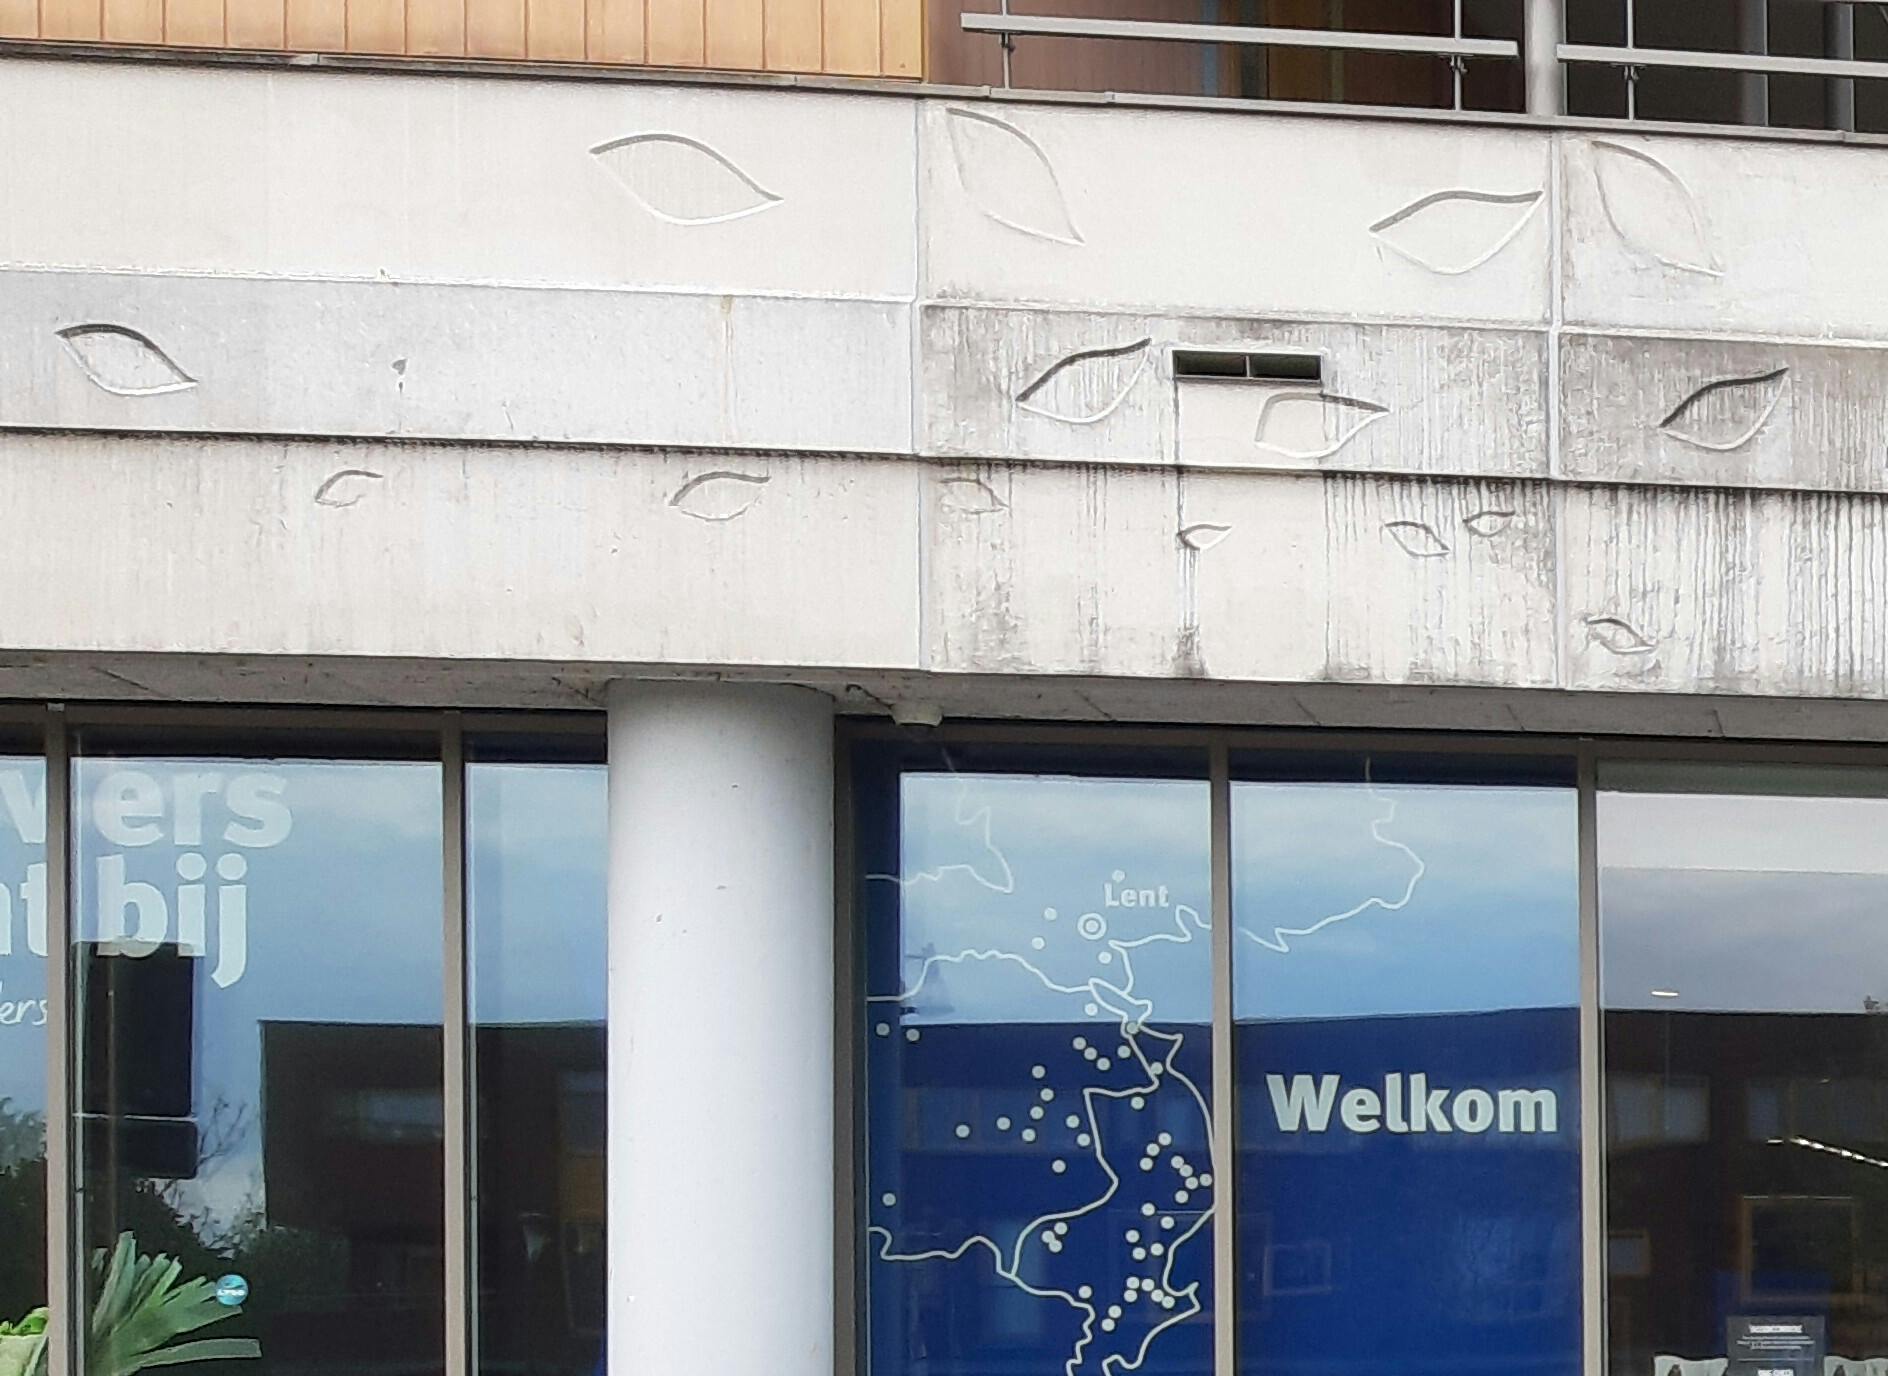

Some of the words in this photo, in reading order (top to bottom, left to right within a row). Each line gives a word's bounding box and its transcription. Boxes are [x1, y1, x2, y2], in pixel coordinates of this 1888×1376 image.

[96, 852, 247, 989] bij
[1104, 881, 1169, 907] Lent
[1267, 1071, 1557, 1134] Welkom
